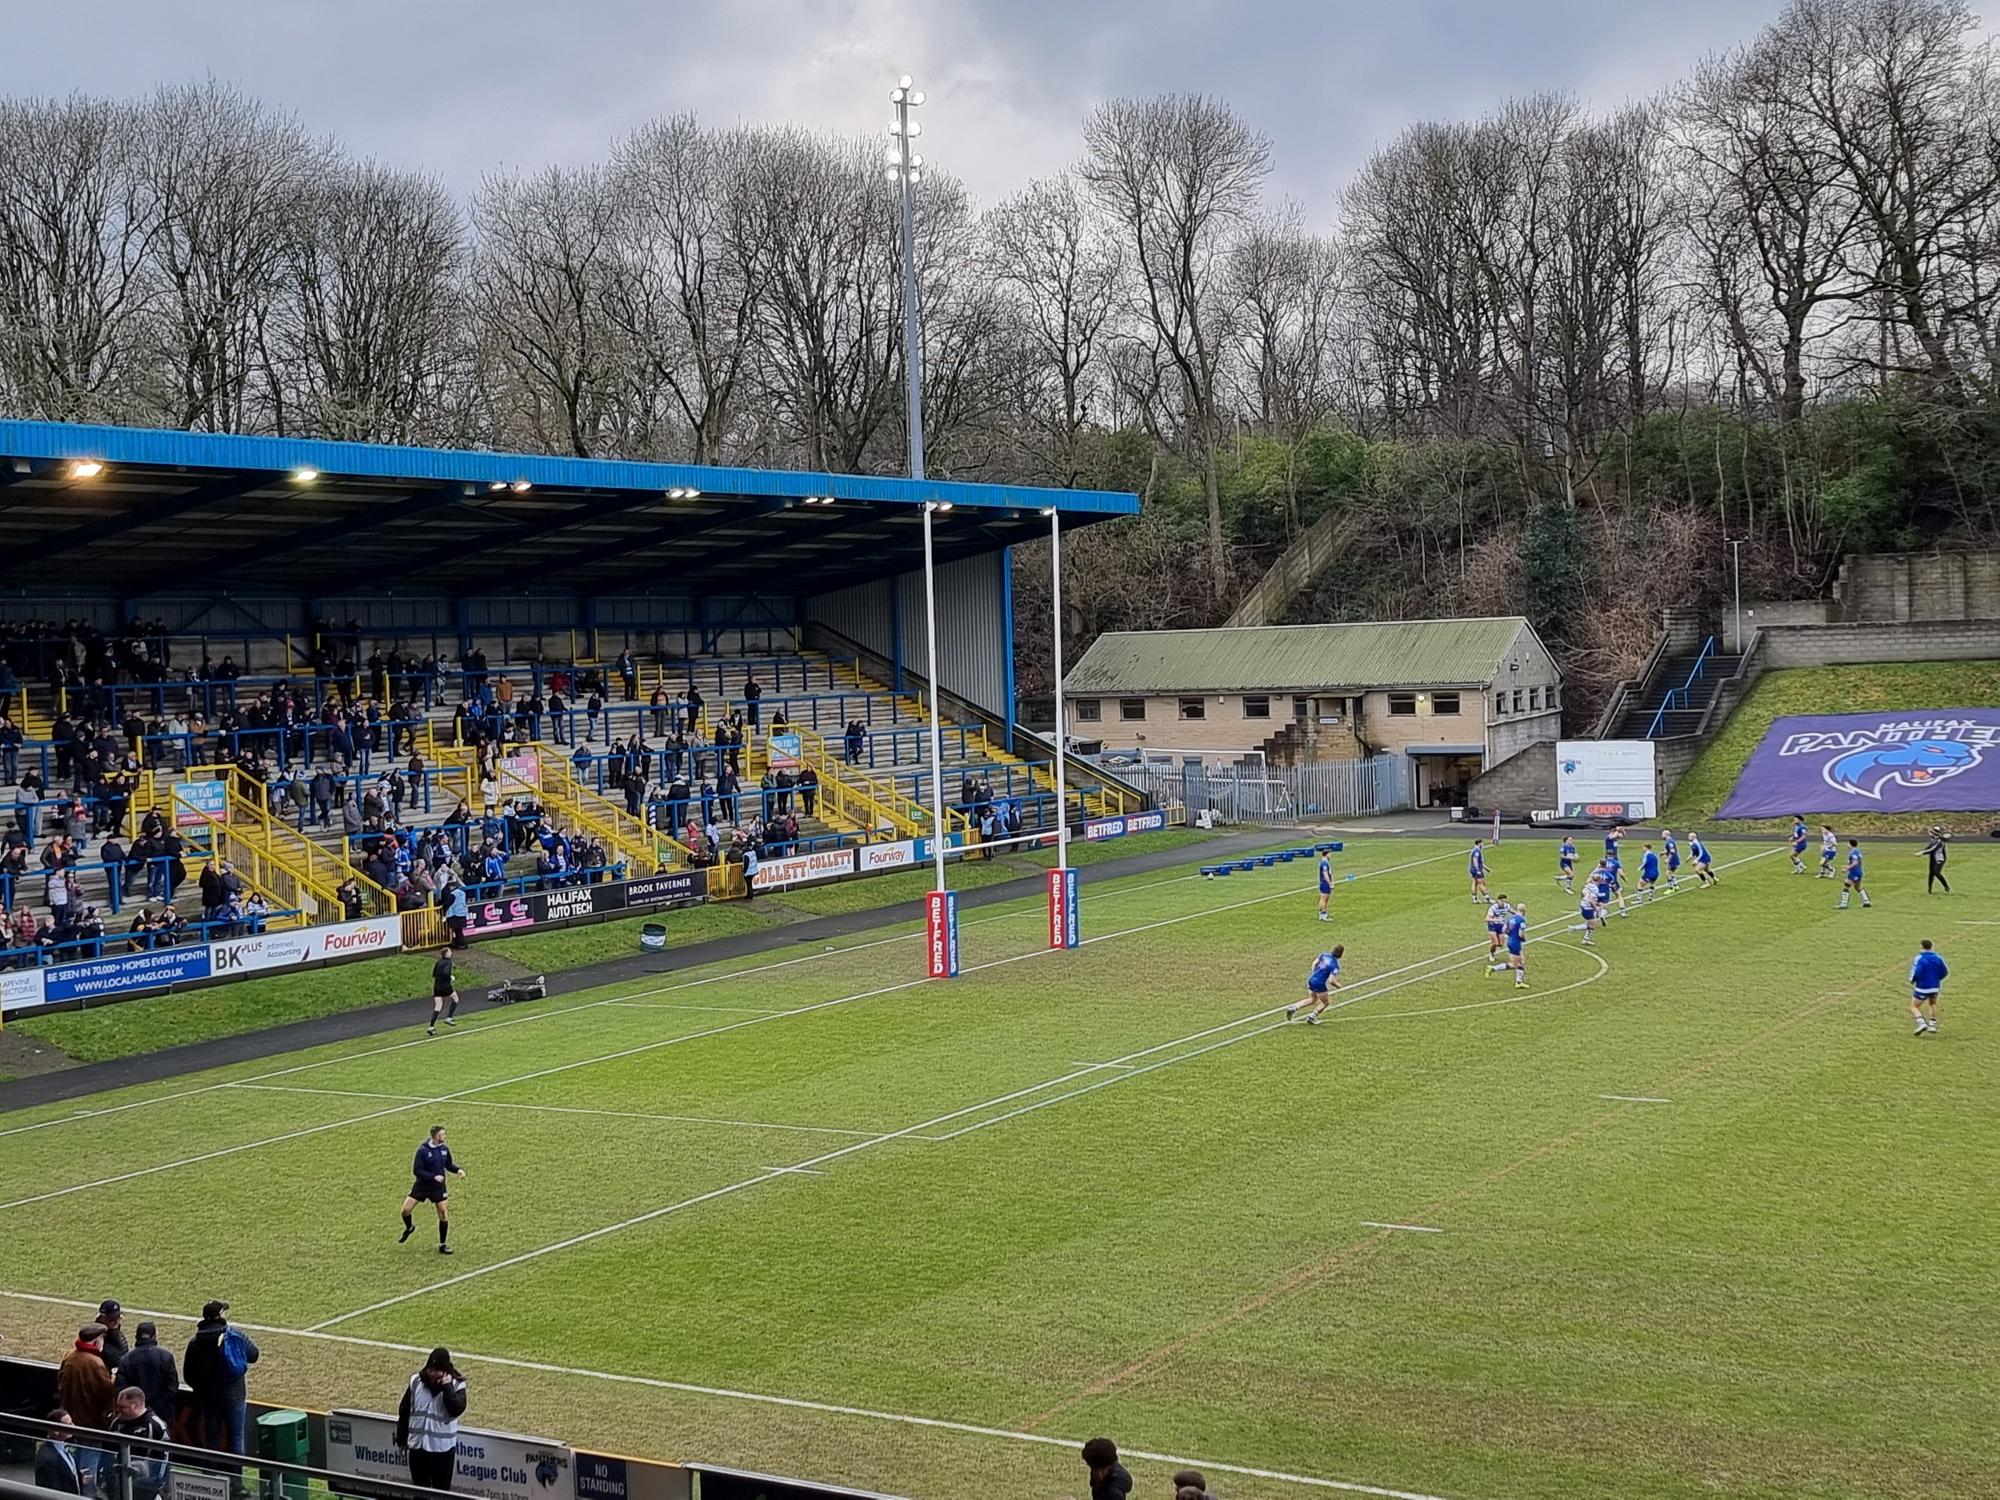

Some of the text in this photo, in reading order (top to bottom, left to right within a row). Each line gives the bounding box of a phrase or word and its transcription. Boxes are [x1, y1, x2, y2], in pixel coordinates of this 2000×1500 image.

[1879, 719, 1977, 730] HALIFAX
[198, 786, 213, 798] YOU
[1585, 804, 1624, 815] GEKKO
[1087, 819, 1124, 839] BETFRED
[1127, 814, 1162, 832] BETFRED
[810, 851, 852, 869] COLLETT
[868, 849, 906, 865] Fourway
[629, 878, 691, 896] BROOK TAVERNER
[547, 889, 592, 906] HALIFAX
[547, 901, 592, 920] AUTO TECH
[1052, 873, 1062, 945] BETFRED
[1067, 873, 1076, 945] BETFRED
[324, 930, 387, 952] Fourway
[931, 896, 944, 974] BETFRED
[215, 944, 244, 971] BK
[266, 947, 302, 959] Accounting
[47, 972, 57, 983] BE
[58, 968, 80, 981] SEEN
[80, 967, 91, 978] IN
[122, 958, 150, 973] HOMES
[151, 953, 175, 967] EVERY
[176, 949, 207, 963] MONTH
[74, 967, 185, 993] WWW.LOCAL-MAGS.CO.UK
[355, 1444, 408, 1467] Wheelcha
[455, 1441, 485, 1459] thers
[525, 1453, 568, 1469] PANTHERS
[594, 1463, 608, 1477] NO
[456, 1461, 527, 1484] League Club
[579, 1478, 625, 1496] STANDING
